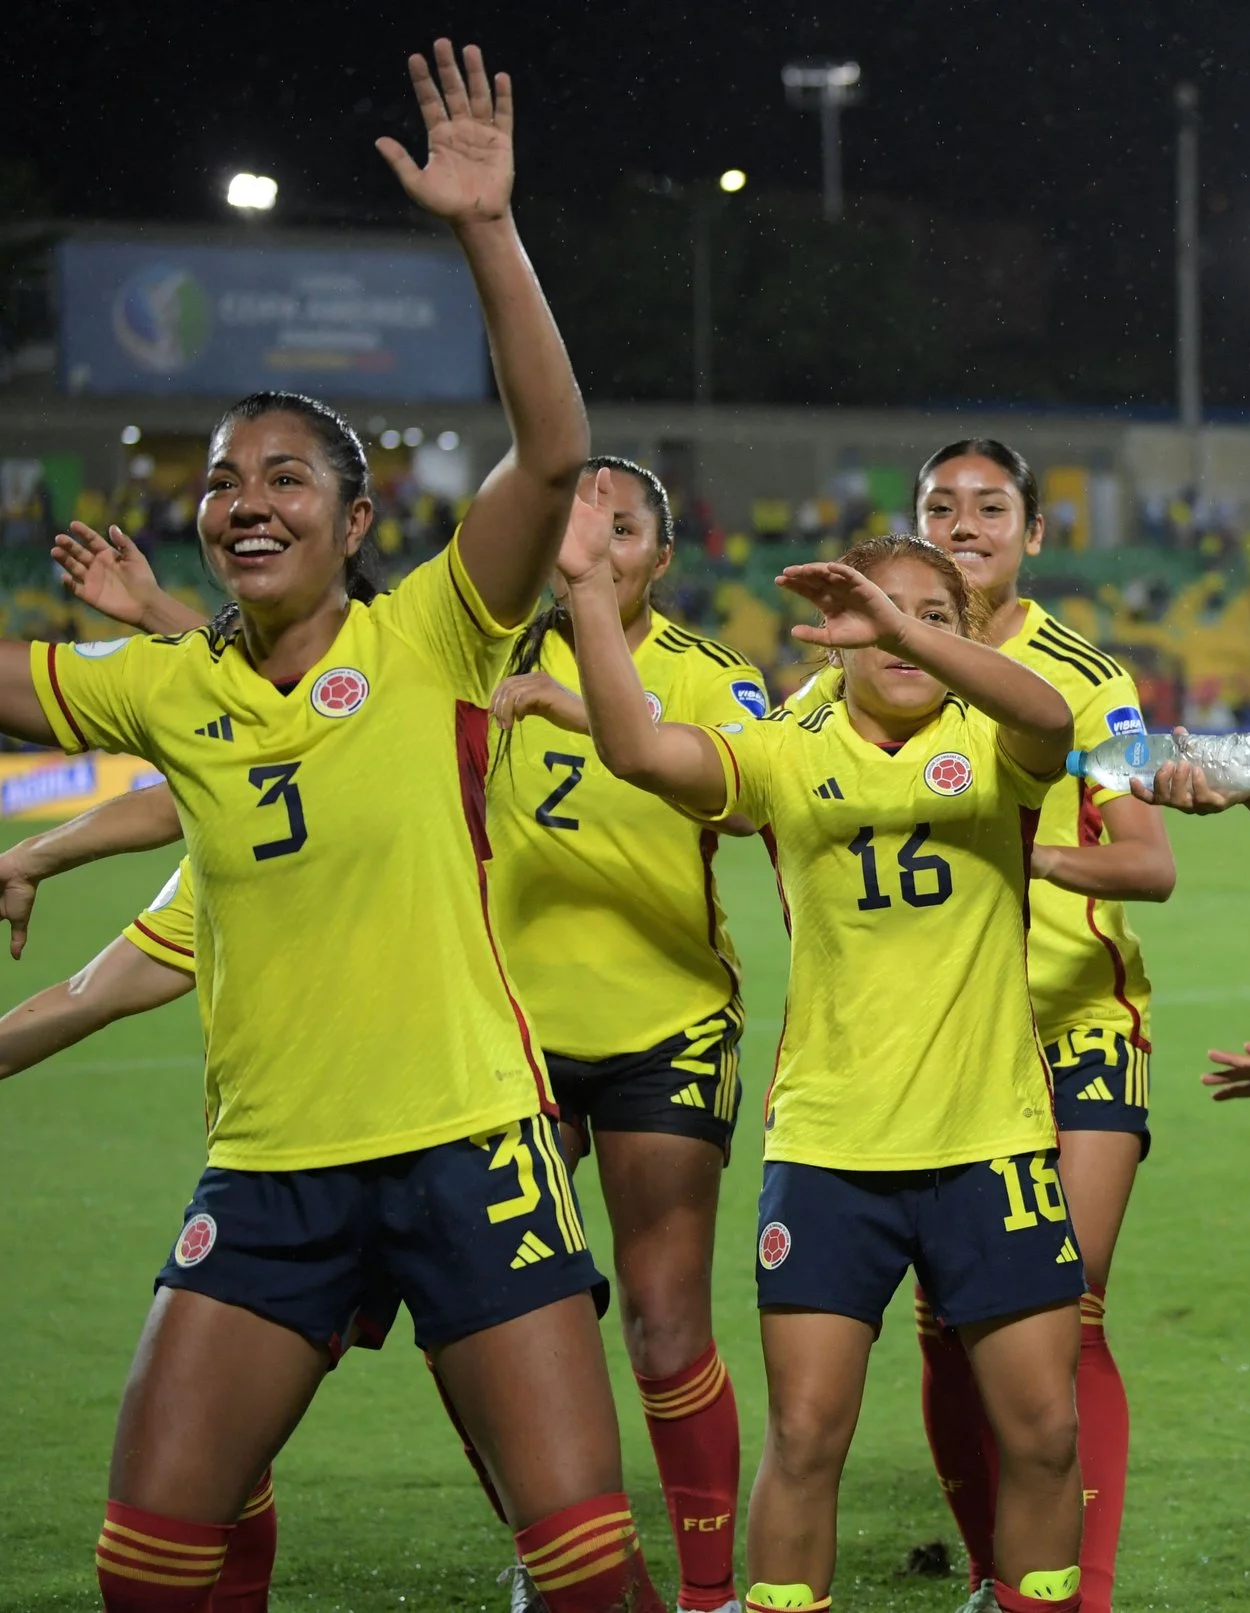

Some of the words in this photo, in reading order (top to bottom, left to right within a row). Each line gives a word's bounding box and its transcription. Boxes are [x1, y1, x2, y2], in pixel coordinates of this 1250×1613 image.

[1113, 719, 1142, 732] VIBRA
[248, 761, 308, 862] 3
[535, 751, 586, 831] 2
[847, 822, 953, 911] 16
[670, 1019, 727, 1076] 2
[1052, 1025, 1120, 1067] 14
[470, 1120, 541, 1224] 3
[683, 1513, 731, 1532] FCF
